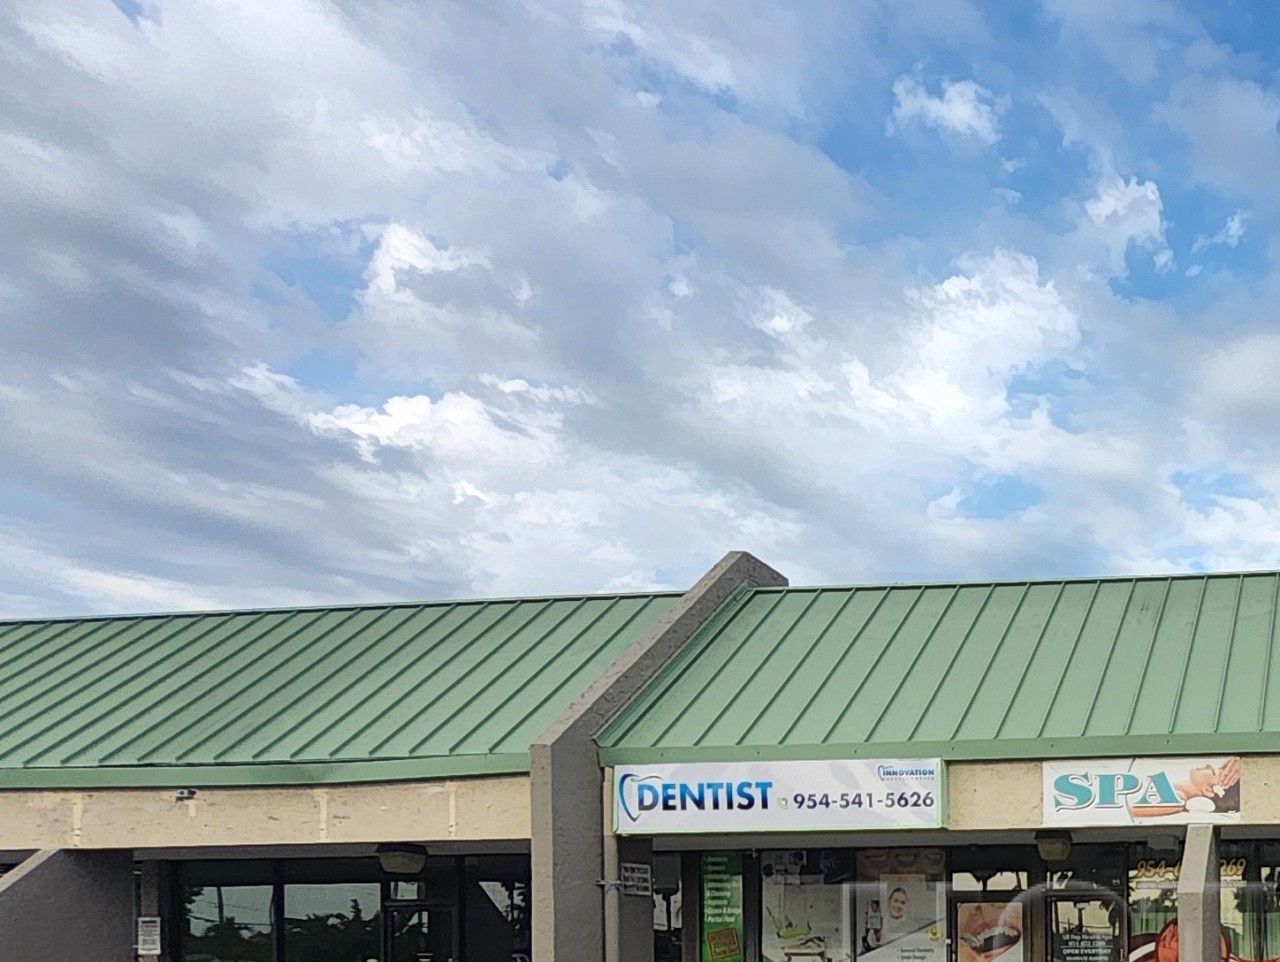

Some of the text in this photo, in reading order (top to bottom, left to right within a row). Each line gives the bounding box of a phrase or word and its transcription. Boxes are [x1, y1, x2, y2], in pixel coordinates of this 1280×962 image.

[637, 781, 935, 811] DENTIST 954-541-5626
[1053, 771, 1185, 812] SPA
